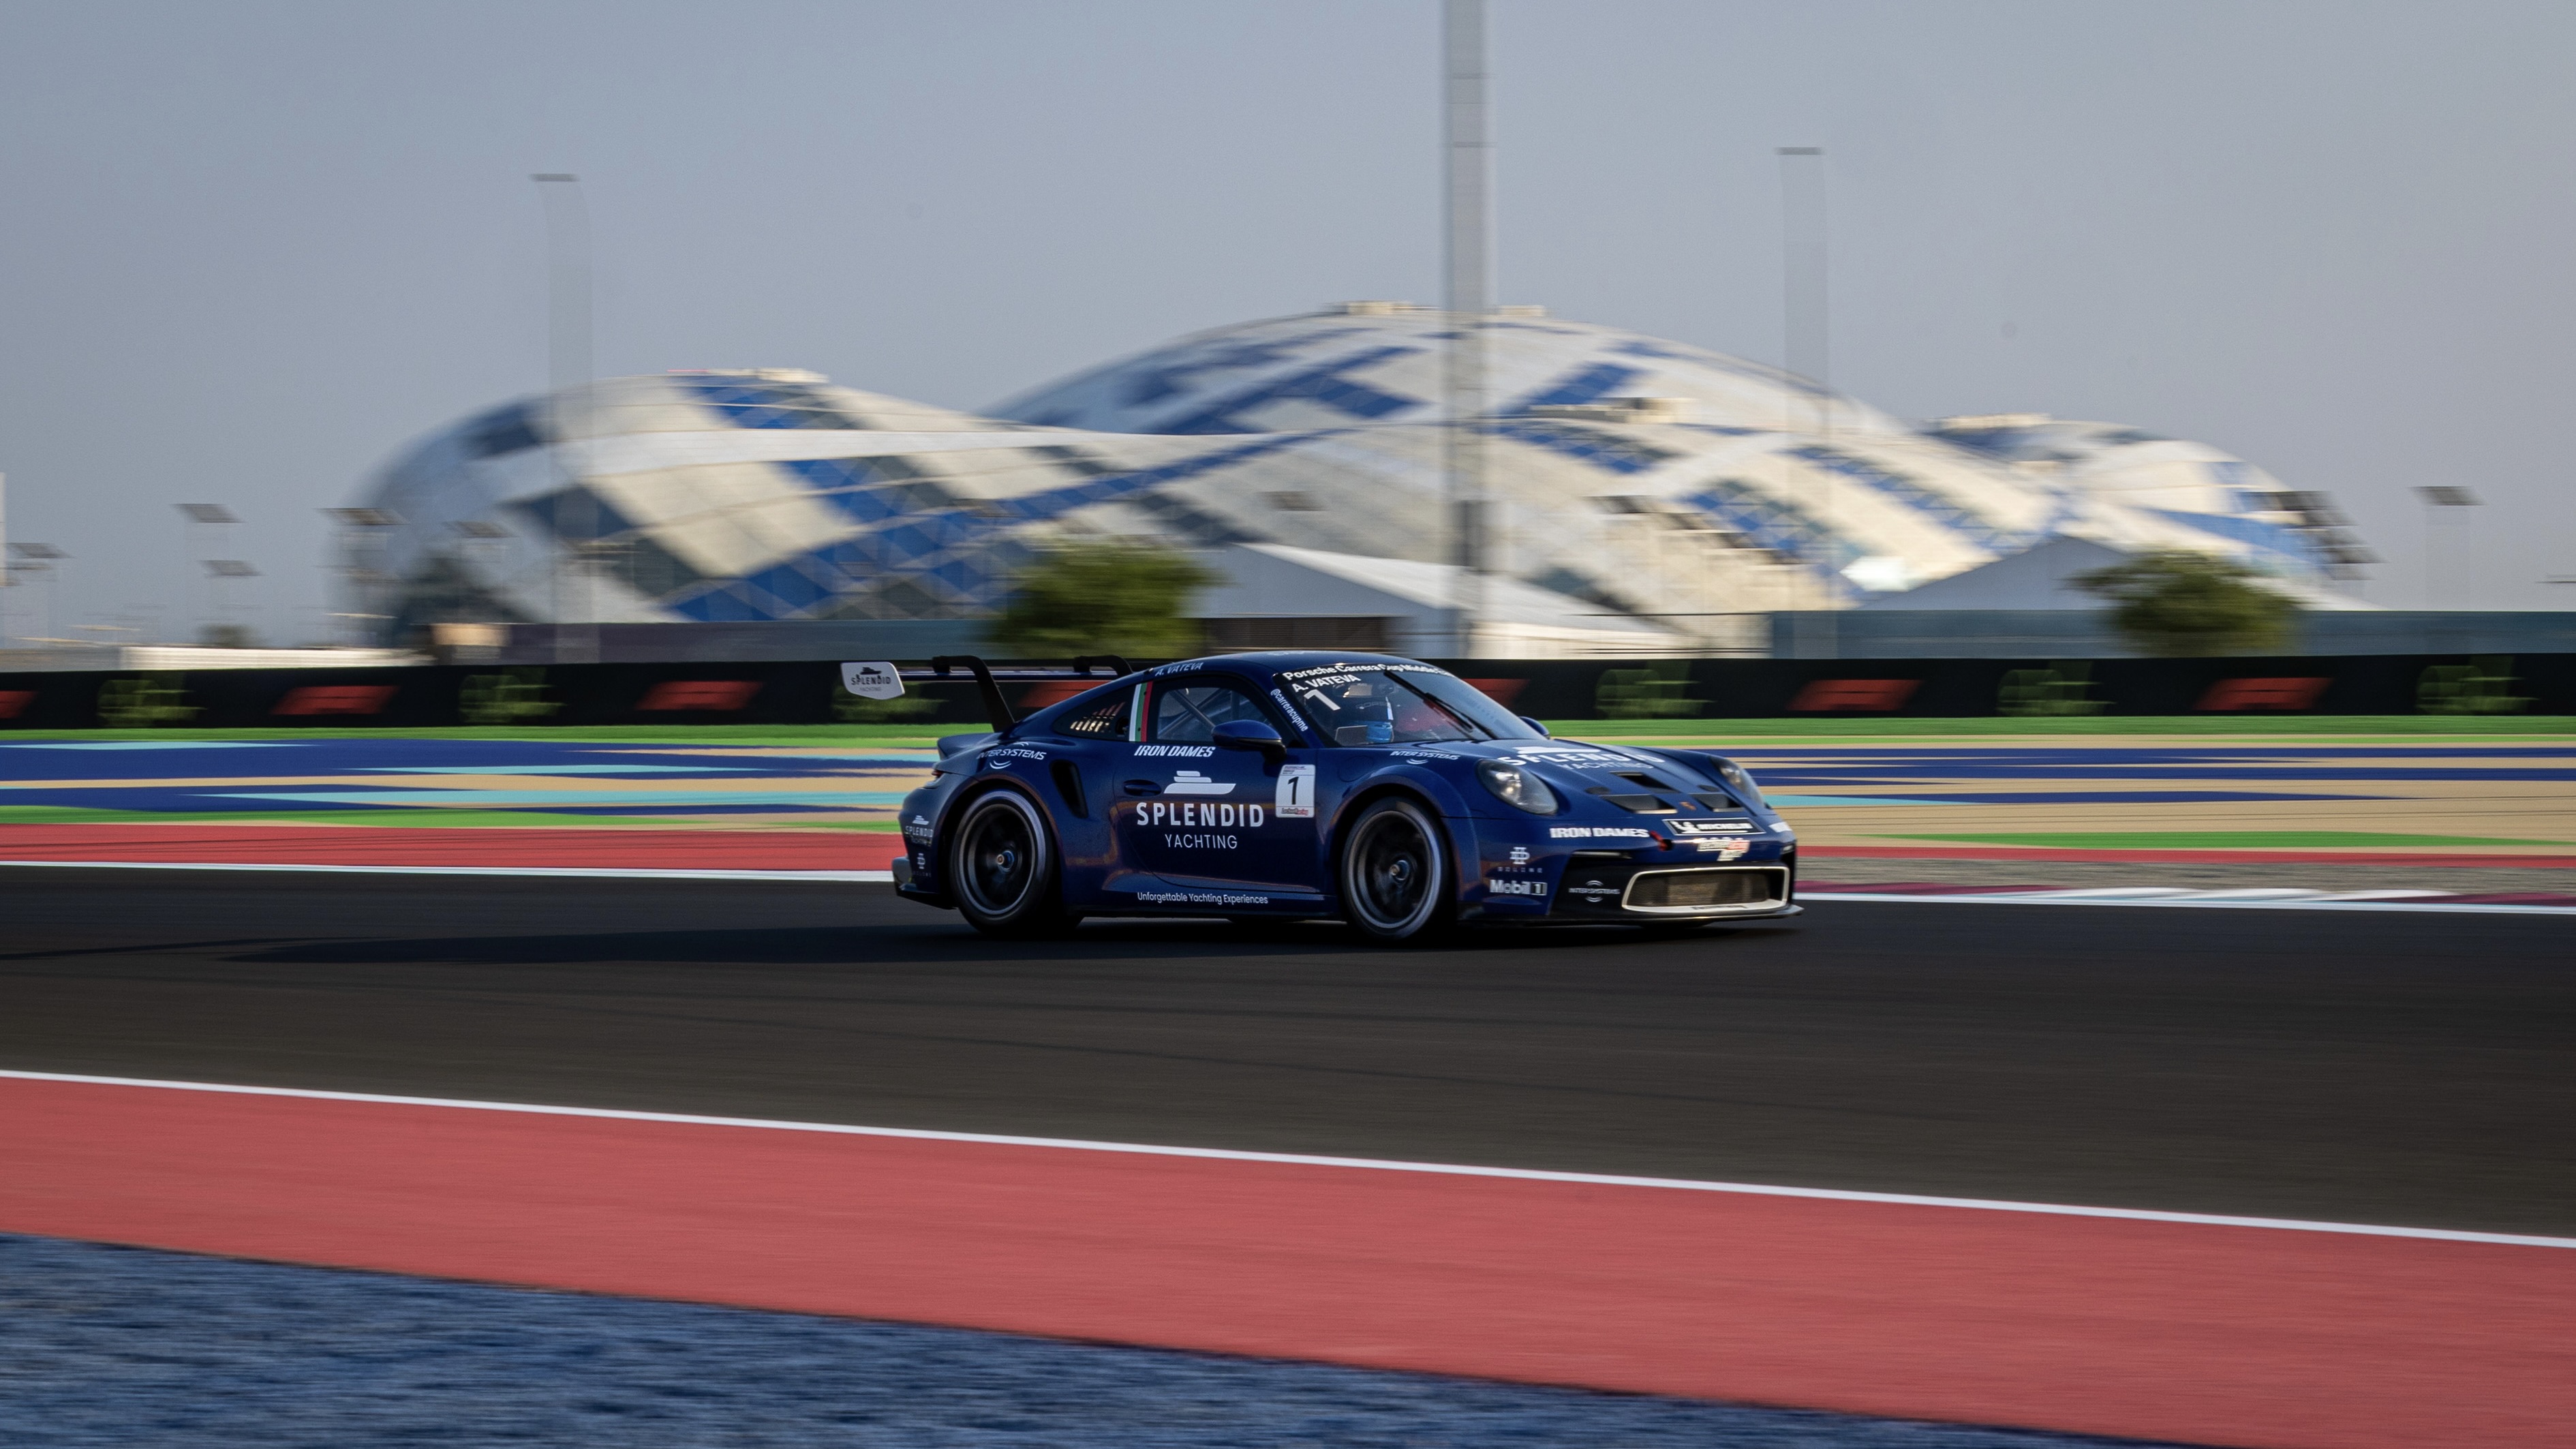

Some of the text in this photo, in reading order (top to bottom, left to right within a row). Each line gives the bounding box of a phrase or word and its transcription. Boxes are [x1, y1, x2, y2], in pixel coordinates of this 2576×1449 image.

[1155, 662, 1204, 677] A. VATEVA
[1282, 667, 1337, 680] Porsche
[1334, 665, 1381, 673] Carrera
[850, 676, 891, 686] SPLENDID
[1291, 674, 1362, 692] A. VATEVA
[1303, 688, 1341, 711] 1
[1134, 745, 1216, 758] IRON DAMES
[1497, 752, 1666, 766] SPLENDID
[1287, 776, 1300, 806] 1
[1135, 802, 1264, 827] SPLENDID
[1549, 827, 1650, 838] IRON DAMES
[1164, 834, 1238, 850] YACHTING
[1490, 879, 1531, 895] Mobil
[1137, 891, 1269, 906] Unforgettable Yachting Experiences
